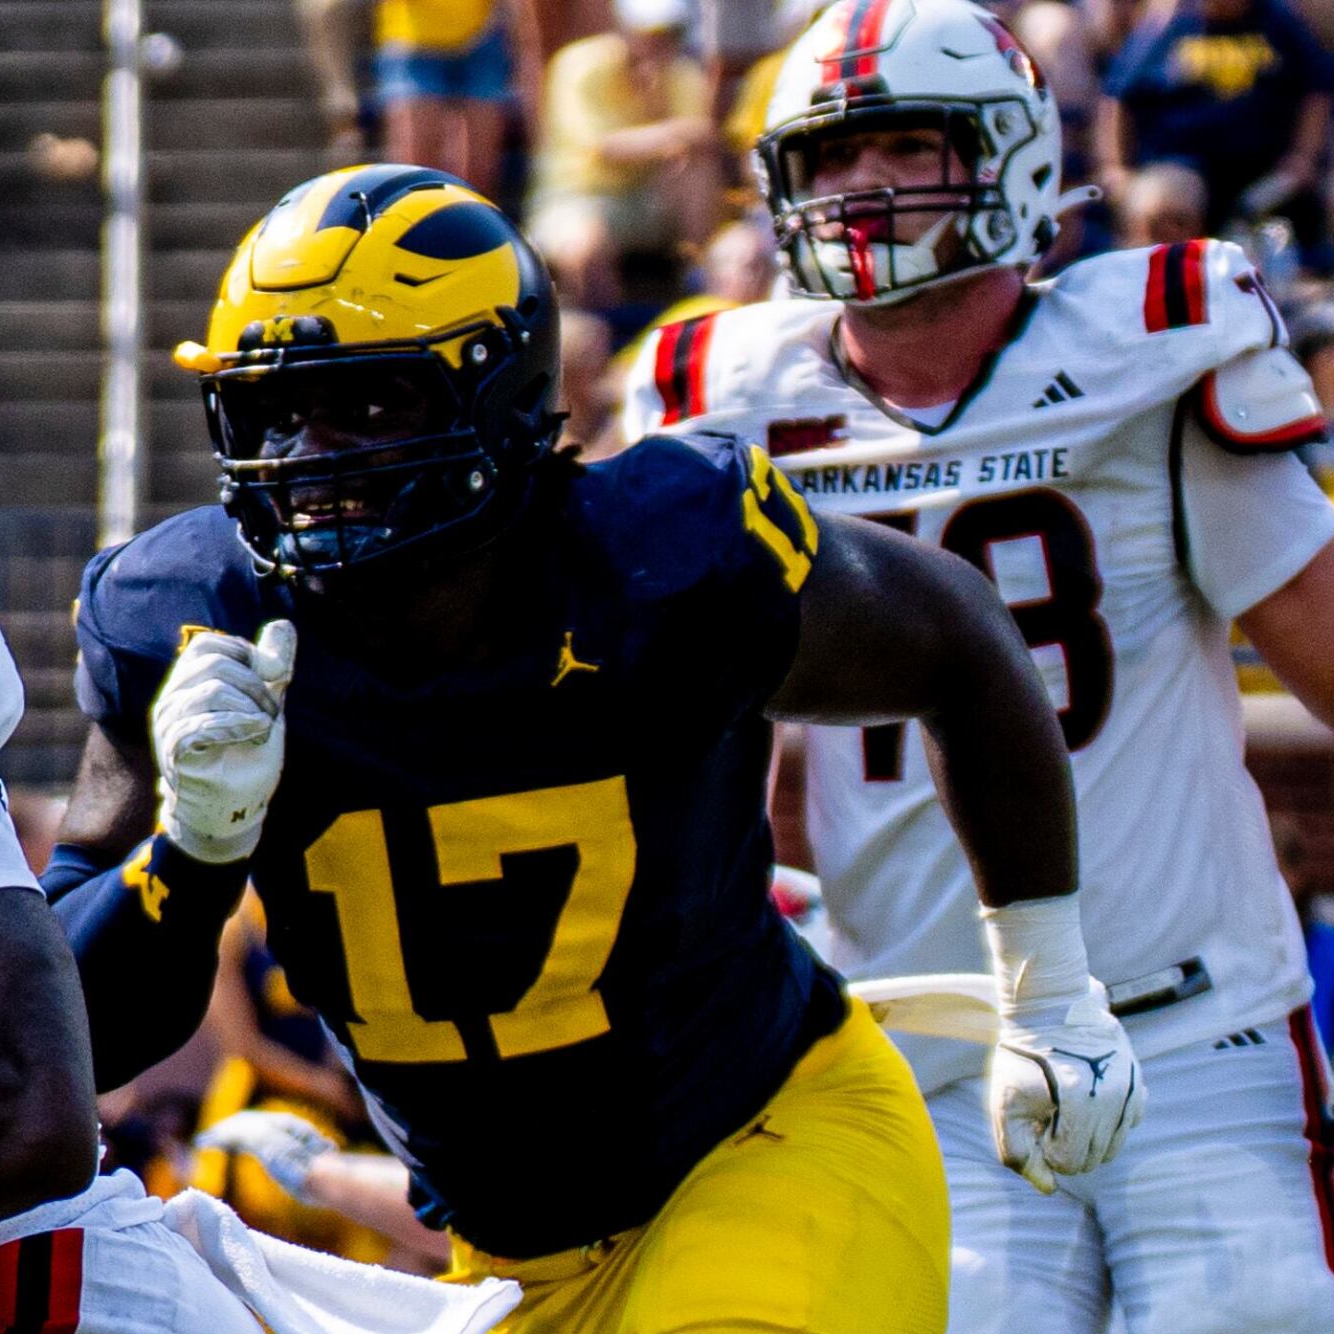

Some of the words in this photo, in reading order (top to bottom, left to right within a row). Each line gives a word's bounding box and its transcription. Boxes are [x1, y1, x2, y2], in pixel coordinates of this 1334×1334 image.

[803, 459, 964, 495] ARKANSAS
[977, 447, 1069, 484] STATE
[304, 775, 637, 1064] 17
